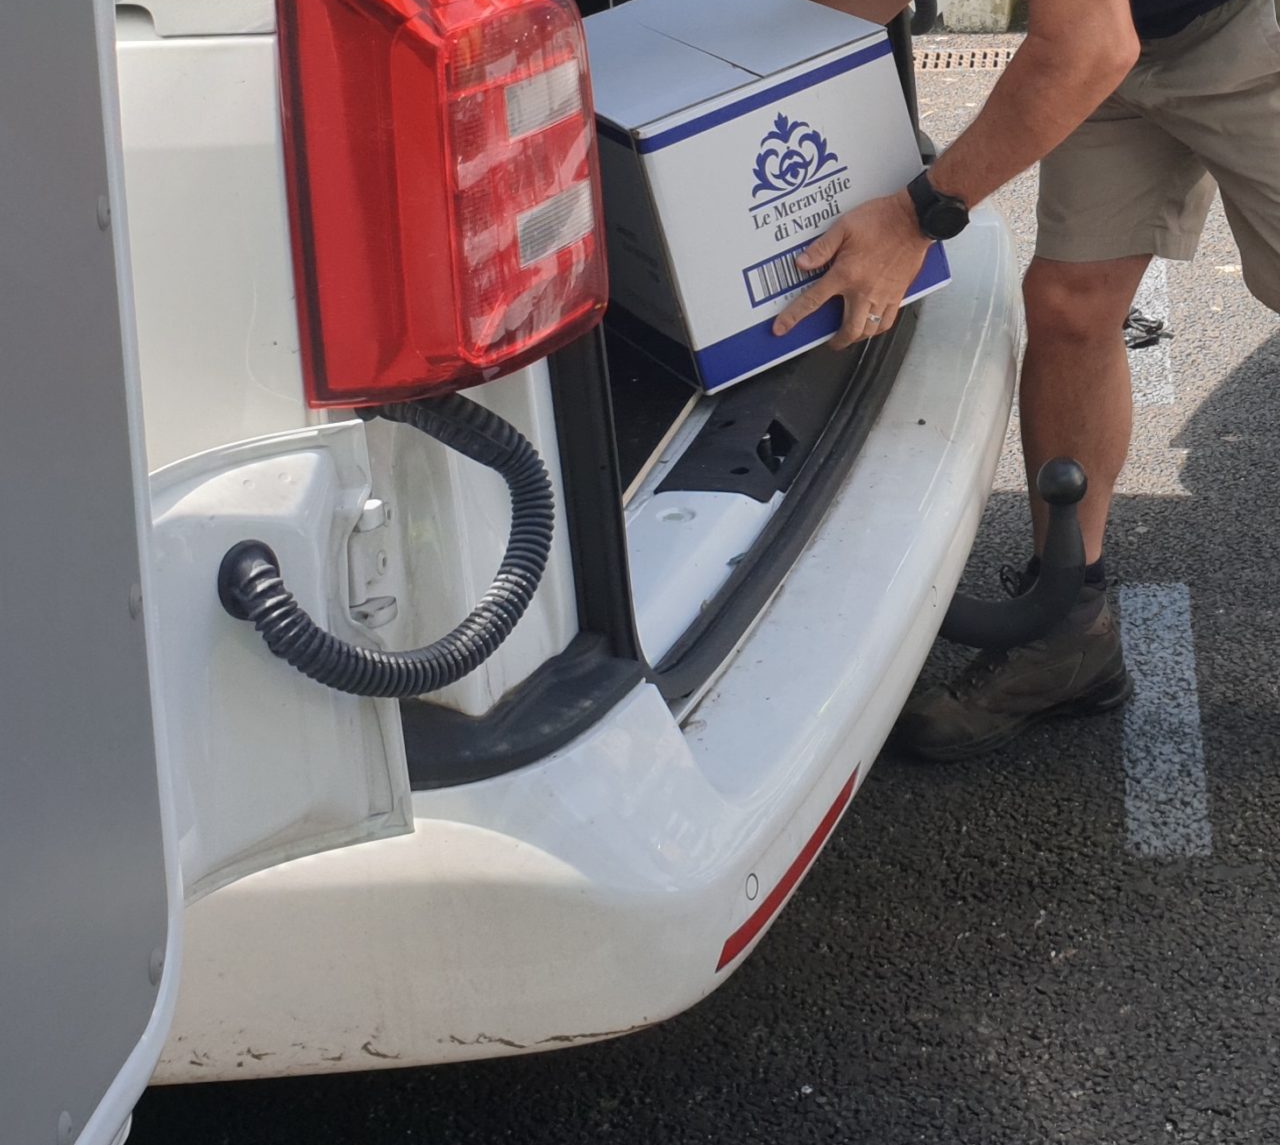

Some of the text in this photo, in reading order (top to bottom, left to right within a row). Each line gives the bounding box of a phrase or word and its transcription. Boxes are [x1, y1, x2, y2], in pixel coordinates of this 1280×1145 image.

[752, 176, 852, 230] Le Meraviglie
[774, 200, 841, 242] di Napoli
